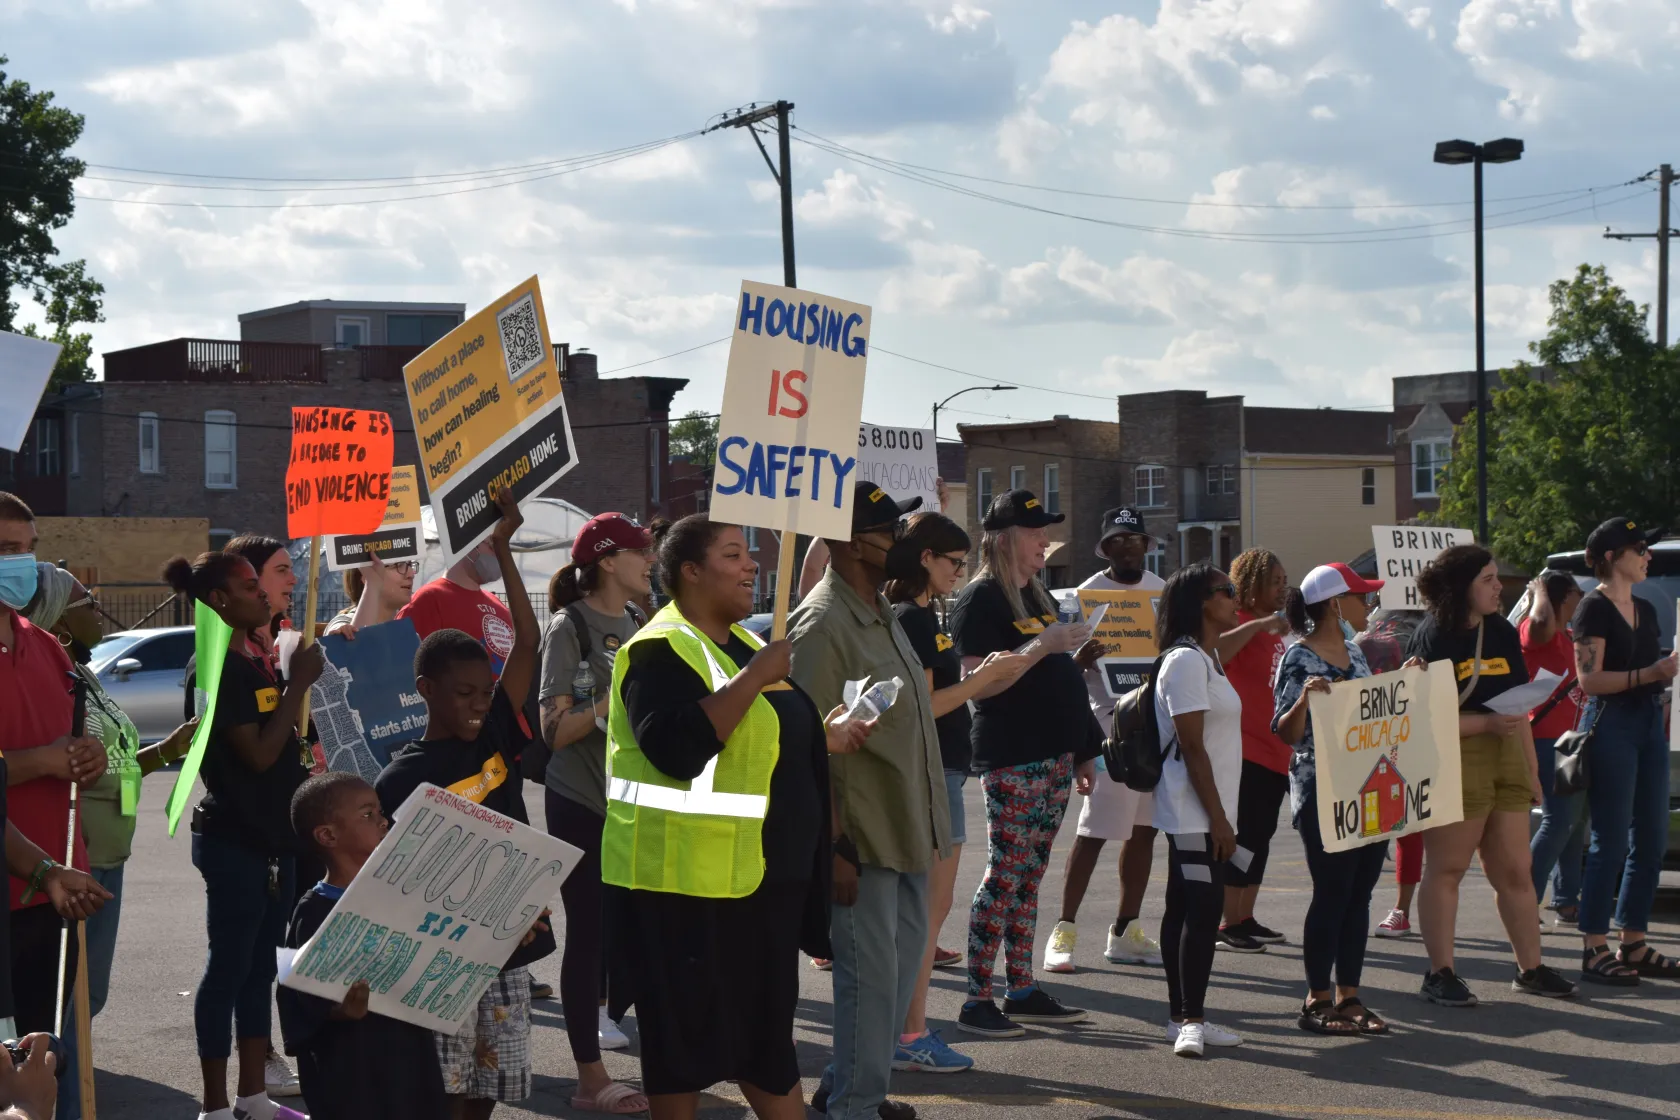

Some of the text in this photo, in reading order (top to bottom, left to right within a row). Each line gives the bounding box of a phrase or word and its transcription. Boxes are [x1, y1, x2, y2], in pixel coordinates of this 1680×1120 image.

[738, 291, 866, 358] HOUSING
[411, 334, 485, 397] Without a place
[417, 371, 478, 425] to call home,
[517, 384, 530, 396] Scan
[529, 379, 536, 387] to
[768, 369, 809, 419] IS
[294, 407, 389, 436] HOUSING IS
[423, 382, 501, 453] how can healing
[300, 442, 340, 464] BRIDGE
[346, 443, 367, 462] TO
[858, 427, 923, 451] 58,000
[429, 441, 463, 480] begin?
[715, 435, 856, 509] SAFETY
[857, 460, 937, 492] HICAGOANS
[287, 471, 390, 515] END VIOLENCE
[456, 432, 559, 529] BRING CHICAGO HOME
[1114, 516, 1138, 525] GUCCI
[341, 537, 412, 556] BRING CHICAGO HOME
[593, 538, 616, 552] GAA
[1391, 530, 1456, 550] BRING
[1121, 600, 1141, 611] place
[1122, 628, 1153, 640] healing
[1115, 673, 1141, 685] BRING
[398, 690, 426, 708] Heal
[1360, 679, 1409, 721] BRING
[370, 721, 400, 740] starts
[399, 716, 413, 731] at
[1345, 715, 1410, 752] CHICAGO
[424, 787, 514, 834] #BRINGCHICAGOHOME
[373, 806, 563, 941] HOUSING
[416, 911, 470, 942] IS A
[296, 912, 501, 1022] HUMAN RIGHT
